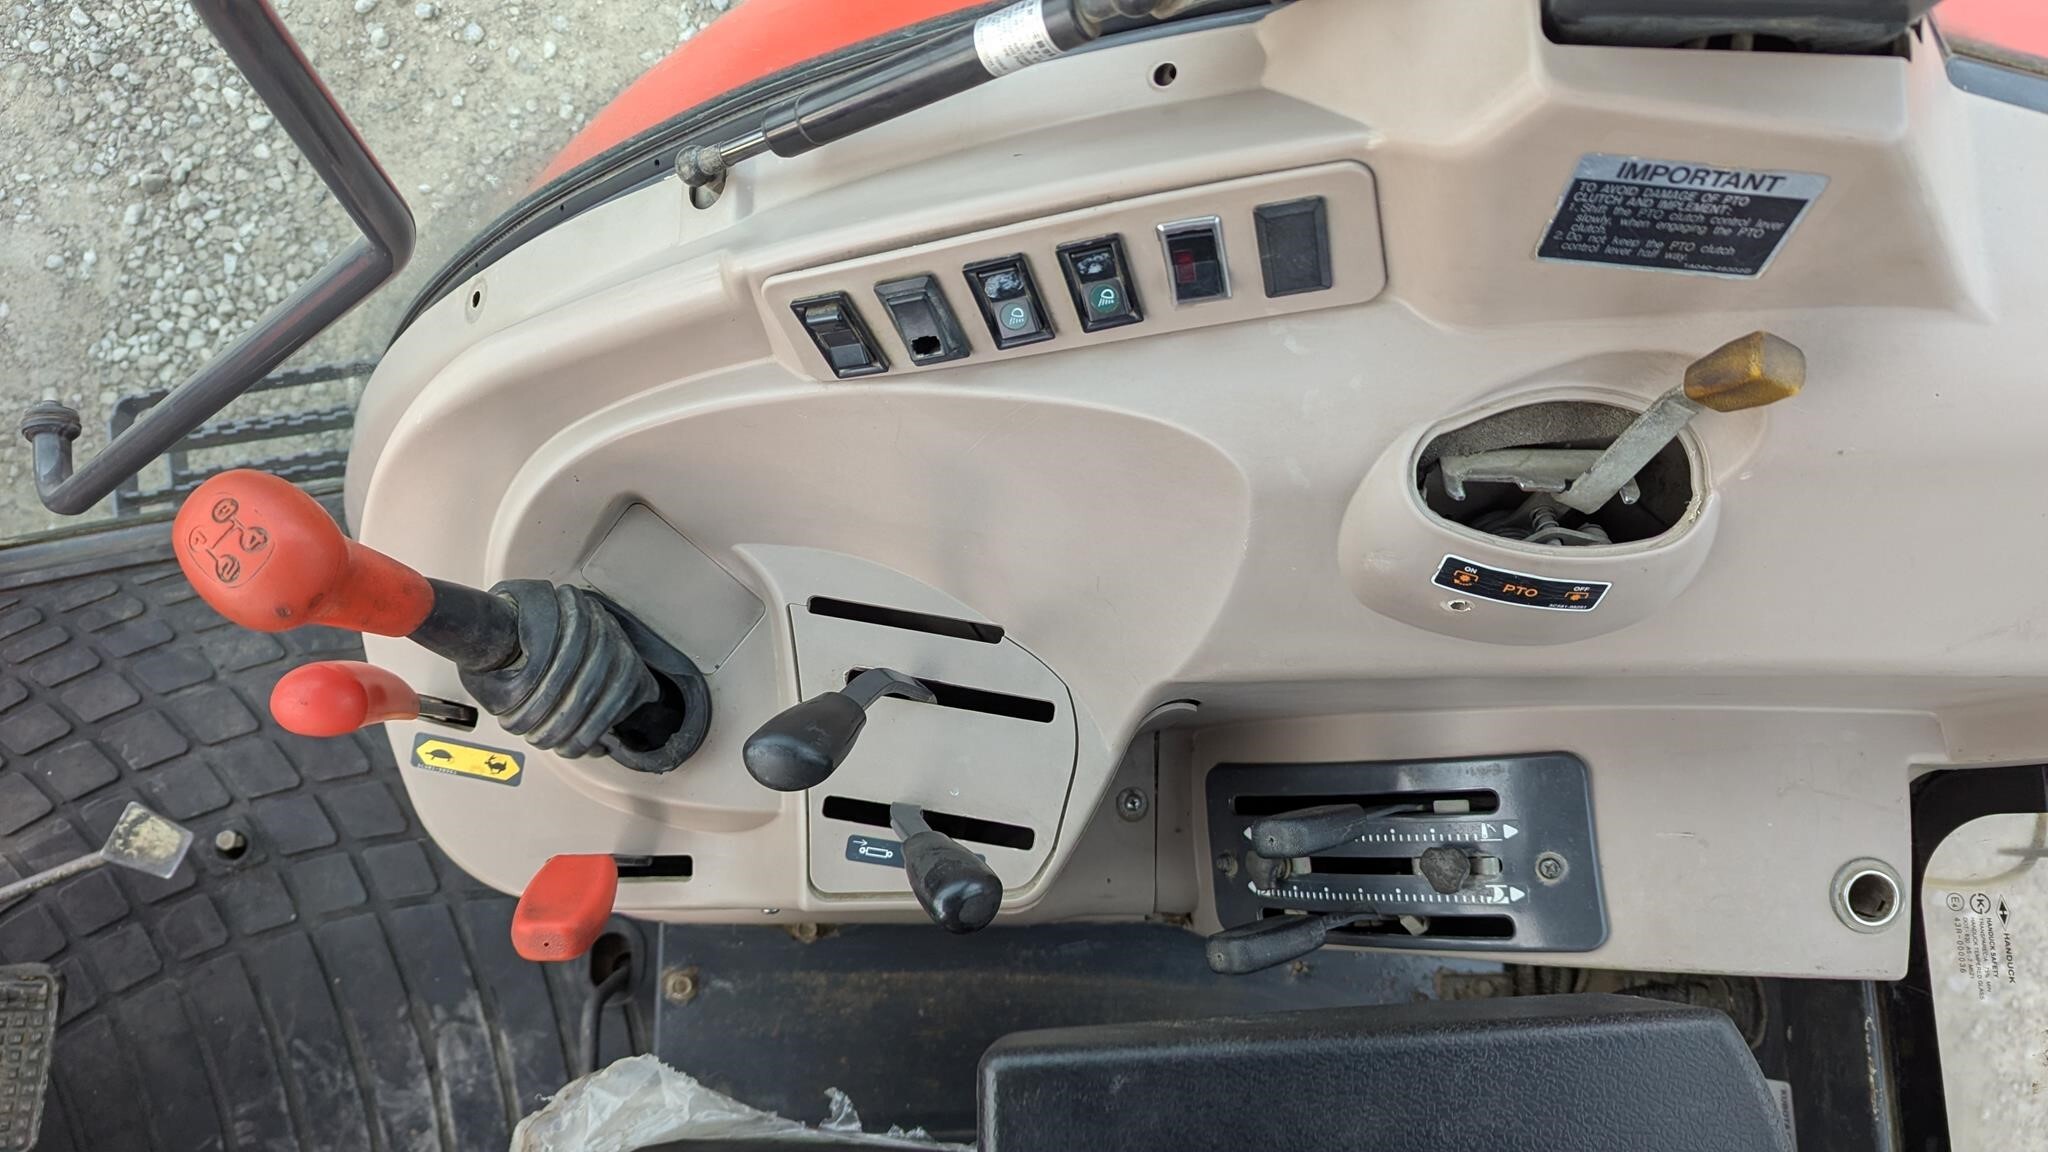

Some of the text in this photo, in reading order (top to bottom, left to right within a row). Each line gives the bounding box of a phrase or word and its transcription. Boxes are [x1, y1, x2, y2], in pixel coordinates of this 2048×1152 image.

[1616, 161, 1787, 192] IMPORTANT
[1573, 191, 1733, 216] CLUTCH AND IMPLEMENT:
[1580, 181, 1751, 207] TO AVOID DAMAGE OF PTO
[1581, 202, 1608, 215] Shift
[1613, 206, 1632, 217] the
[1637, 208, 1665, 220] PTO
[1669, 211, 1705, 224] clutch
[1710, 215, 1752, 228] control
[1755, 219, 1785, 231] lever
[1620, 217, 1650, 229] when
[1655, 221, 1708, 236] engaging
[1712, 226, 1733, 237] the
[1737, 227, 1765, 239] PTO
[1561, 242, 1601, 254] control
[1604, 245, 1633, 257] lever
[1637, 247, 1661, 259] half
[1566, 231, 1582, 242] Do
[1588, 234, 1608, 244] not
[1611, 235, 1641, 248] keep
[1645, 239, 1665, 249] the
[1669, 241, 1696, 252] PTO
[1700, 243, 1736, 256] clutch
[1464, 566, 1478, 575] ON
[1503, 583, 1539, 598] PTO
[1971, 917, 1979, 946] HANDUCK
[1954, 917, 1967, 974] 43R-000036
[1987, 917, 1999, 978] HANDUCK SAFETY
[2003, 932, 2016, 984] HANDUCK
[1974, 947, 1982, 979] TEMPERED
